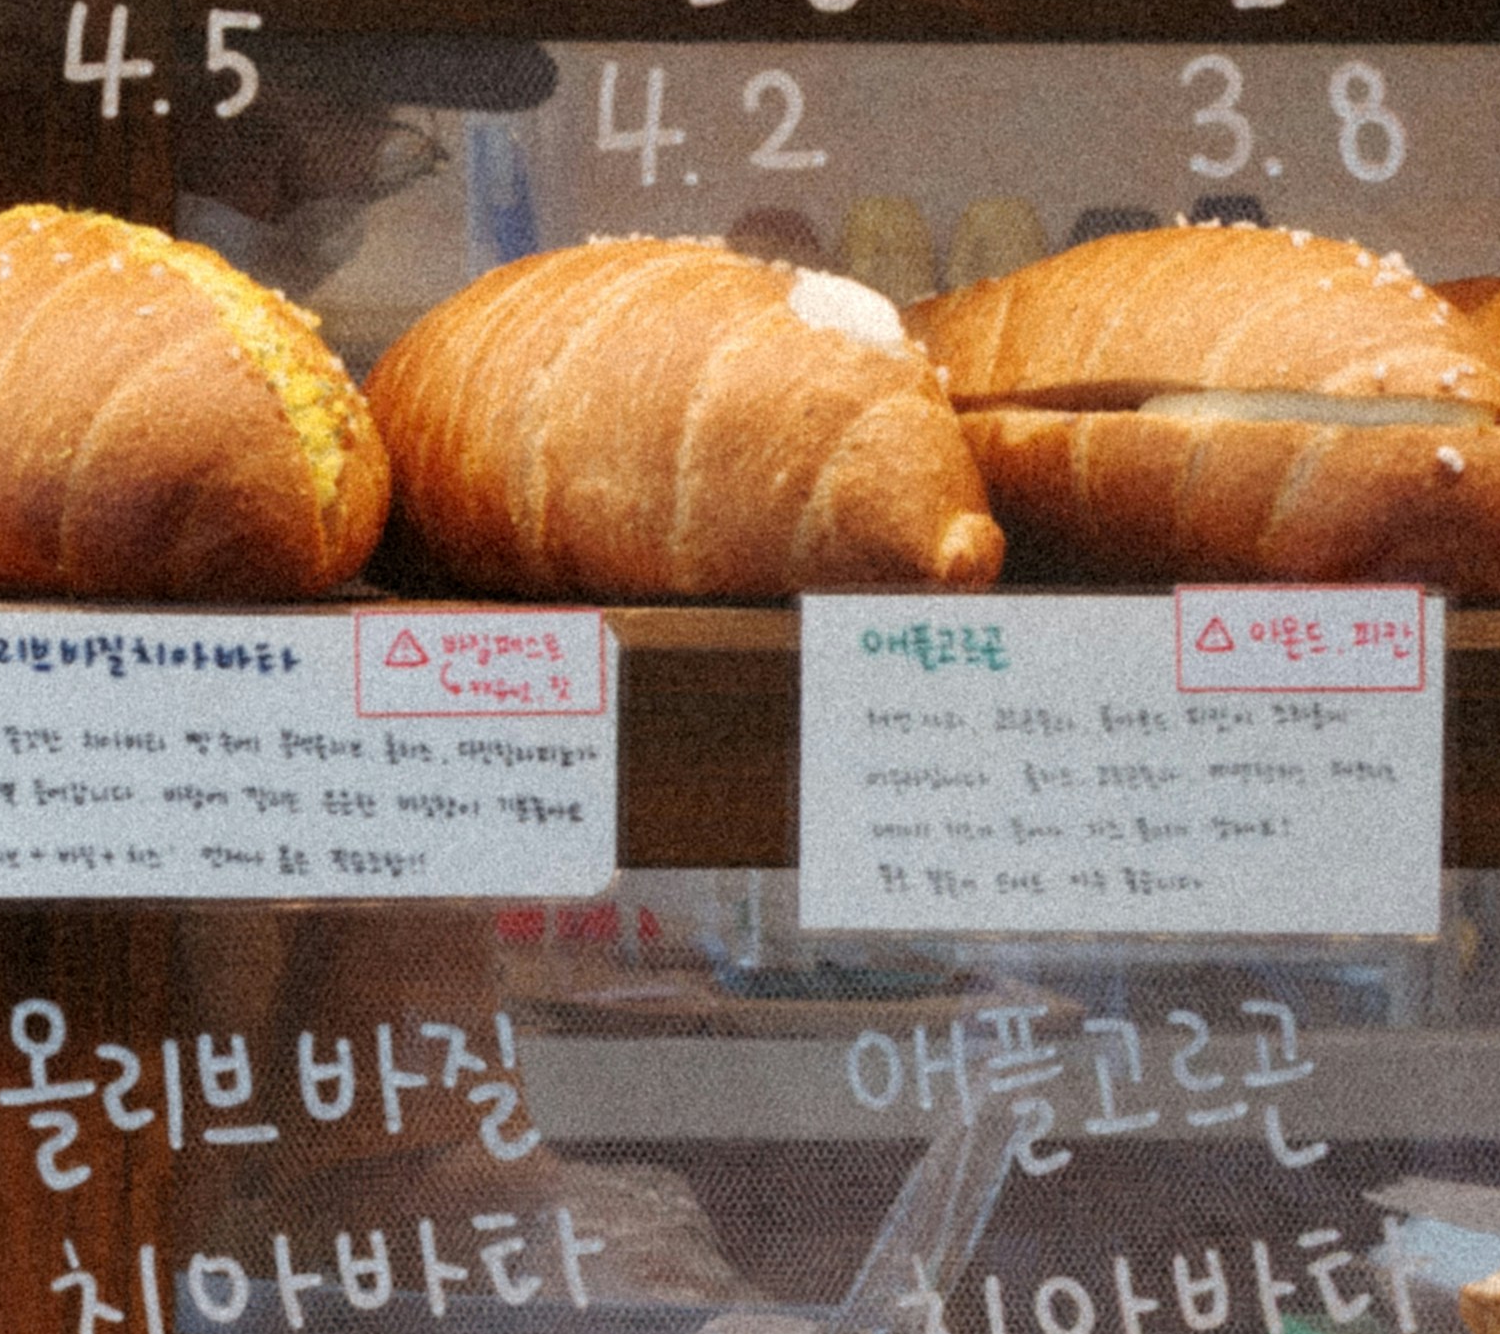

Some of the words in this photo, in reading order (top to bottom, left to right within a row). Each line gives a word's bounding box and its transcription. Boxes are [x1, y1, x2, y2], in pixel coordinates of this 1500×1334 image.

[63, 0, 263, 119] 4.5
[1180, 54, 1408, 183] 3.8
[597, 62, 830, 188] 4.2
